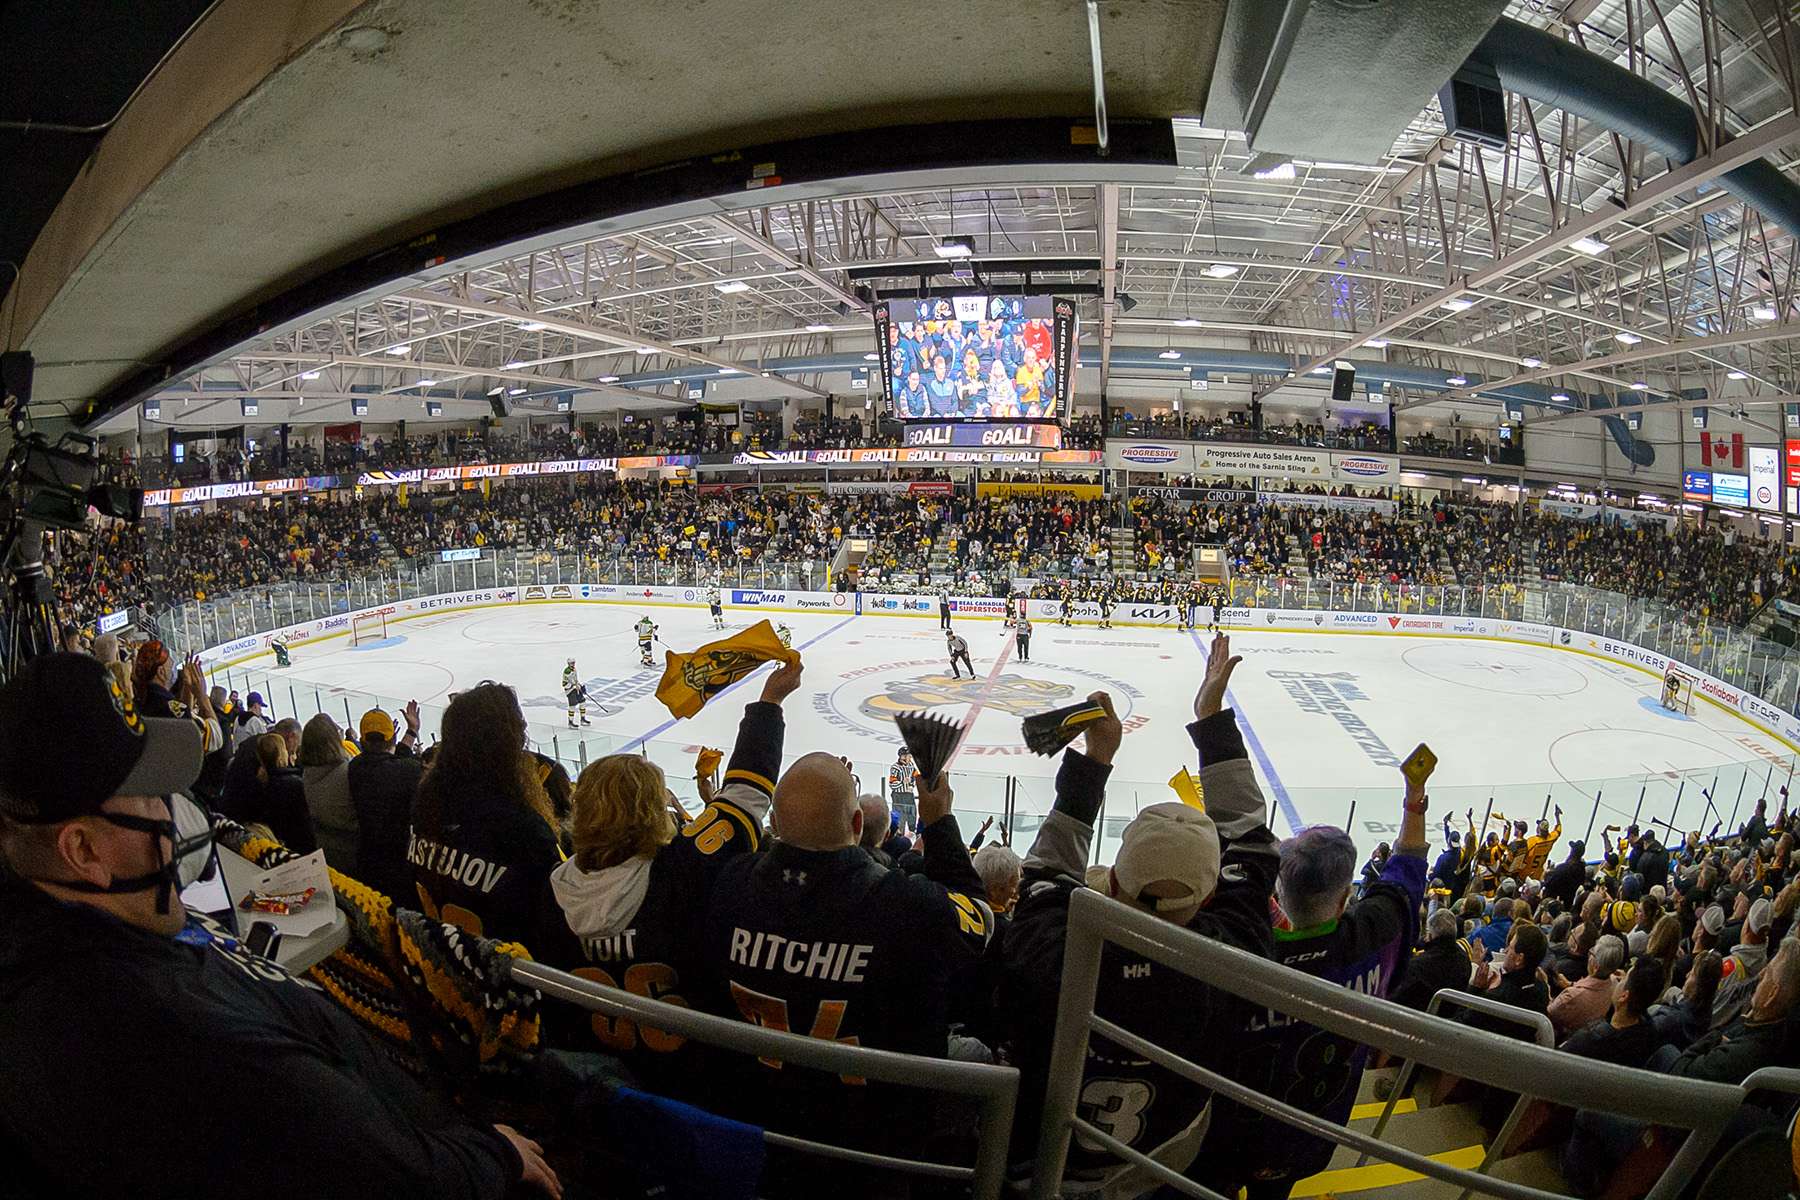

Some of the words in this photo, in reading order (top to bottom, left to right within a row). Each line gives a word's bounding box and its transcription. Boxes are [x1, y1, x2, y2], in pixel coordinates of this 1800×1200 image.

[1058, 320, 1066, 398] CARPENTERS
[909, 426, 951, 444] GOAL!
[982, 427, 1033, 445] GOAL!
[815, 449, 851, 463] GOAL!
[861, 449, 897, 462] GOAL!
[907, 450, 943, 462] GOAL!
[1003, 452, 1040, 463] GOAL!
[1121, 449, 1179, 458] PROGRESSIVE
[1206, 449, 1251, 460] Progressive
[1252, 451, 1272, 460] Auto
[1273, 453, 1293, 461] Sales
[1294, 454, 1316, 463] Arena
[469, 464, 500, 477] GOAL!
[508, 462, 540, 475] GOAL!
[549, 460, 578, 473] GOAL!
[586, 458, 618, 472] GOAL!
[1215, 460, 1237, 468] Home
[1238, 461, 1247, 469] of
[1248, 462, 1261, 470] the
[1262, 463, 1287, 471] Sarnia
[1287, 465, 1306, 473] Sting
[1339, 460, 1389, 471] PROGRESSIVE
[831, 487, 847, 495] THE
[1138, 488, 1180, 499] CESTAR
[1207, 490, 1247, 502] GROUP
[591, 585, 616, 593] Lambton
[420, 592, 492, 609] BETRIVERS
[742, 592, 786, 604] WINMAR
[796, 599, 831, 608] Payworks
[1131, 608, 1170, 619] KIA
[1334, 614, 1378, 623] ADVANCED
[1402, 620, 1431, 629] CANADIAN
[1453, 624, 1475, 633] Imperial
[286, 630, 310, 644] ortons
[222, 638, 257, 655] ADVANCED
[1603, 642, 1665, 670] BETRIVERS
[1701, 678, 1739, 706] Scotiabank
[1362, 819, 1449, 834] Brce
[729, 926, 875, 983] RITCHIE
[1283, 950, 1328, 965] CCM
